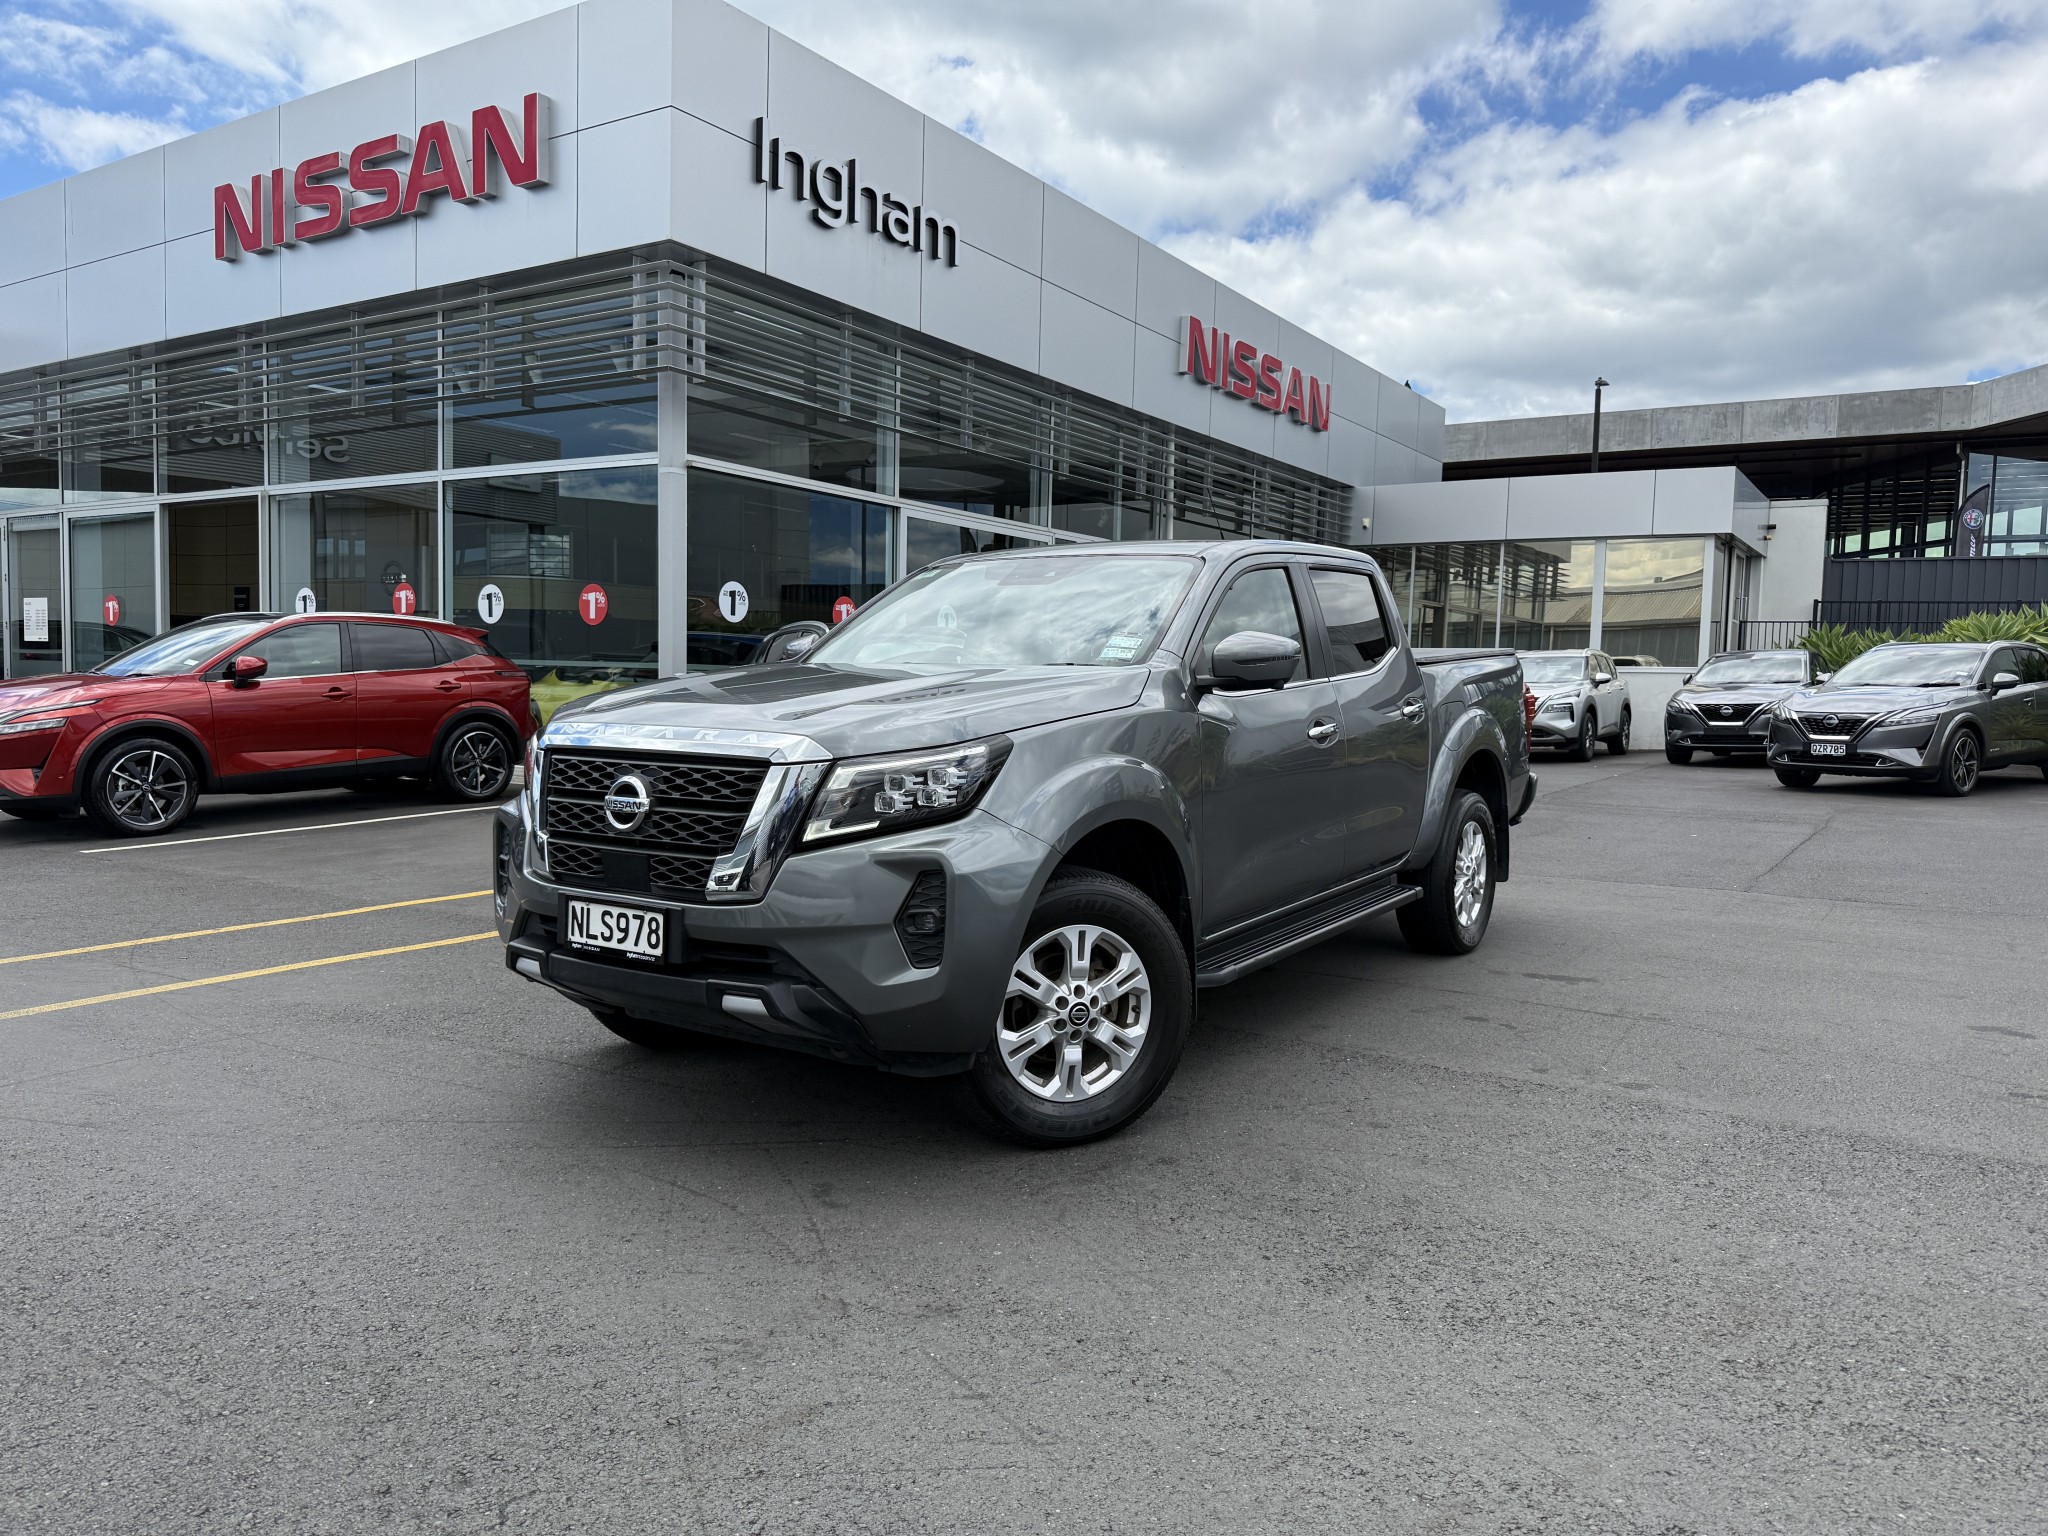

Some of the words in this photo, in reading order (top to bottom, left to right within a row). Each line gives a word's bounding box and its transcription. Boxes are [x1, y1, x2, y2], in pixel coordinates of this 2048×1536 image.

[214, 92, 544, 262] NISSAN
[756, 116, 960, 268] Ingham
[1182, 315, 1330, 432] NISSAN
[400, 590, 413, 613] 1%
[486, 592, 502, 617] 1%
[588, 592, 605, 619] 1%
[729, 590, 746, 616] 1%
[558, 724, 759, 745] NAVARA
[1812, 744, 1845, 754] QZR705
[604, 799, 641, 810] NISSAN
[571, 905, 660, 949] NLS978
